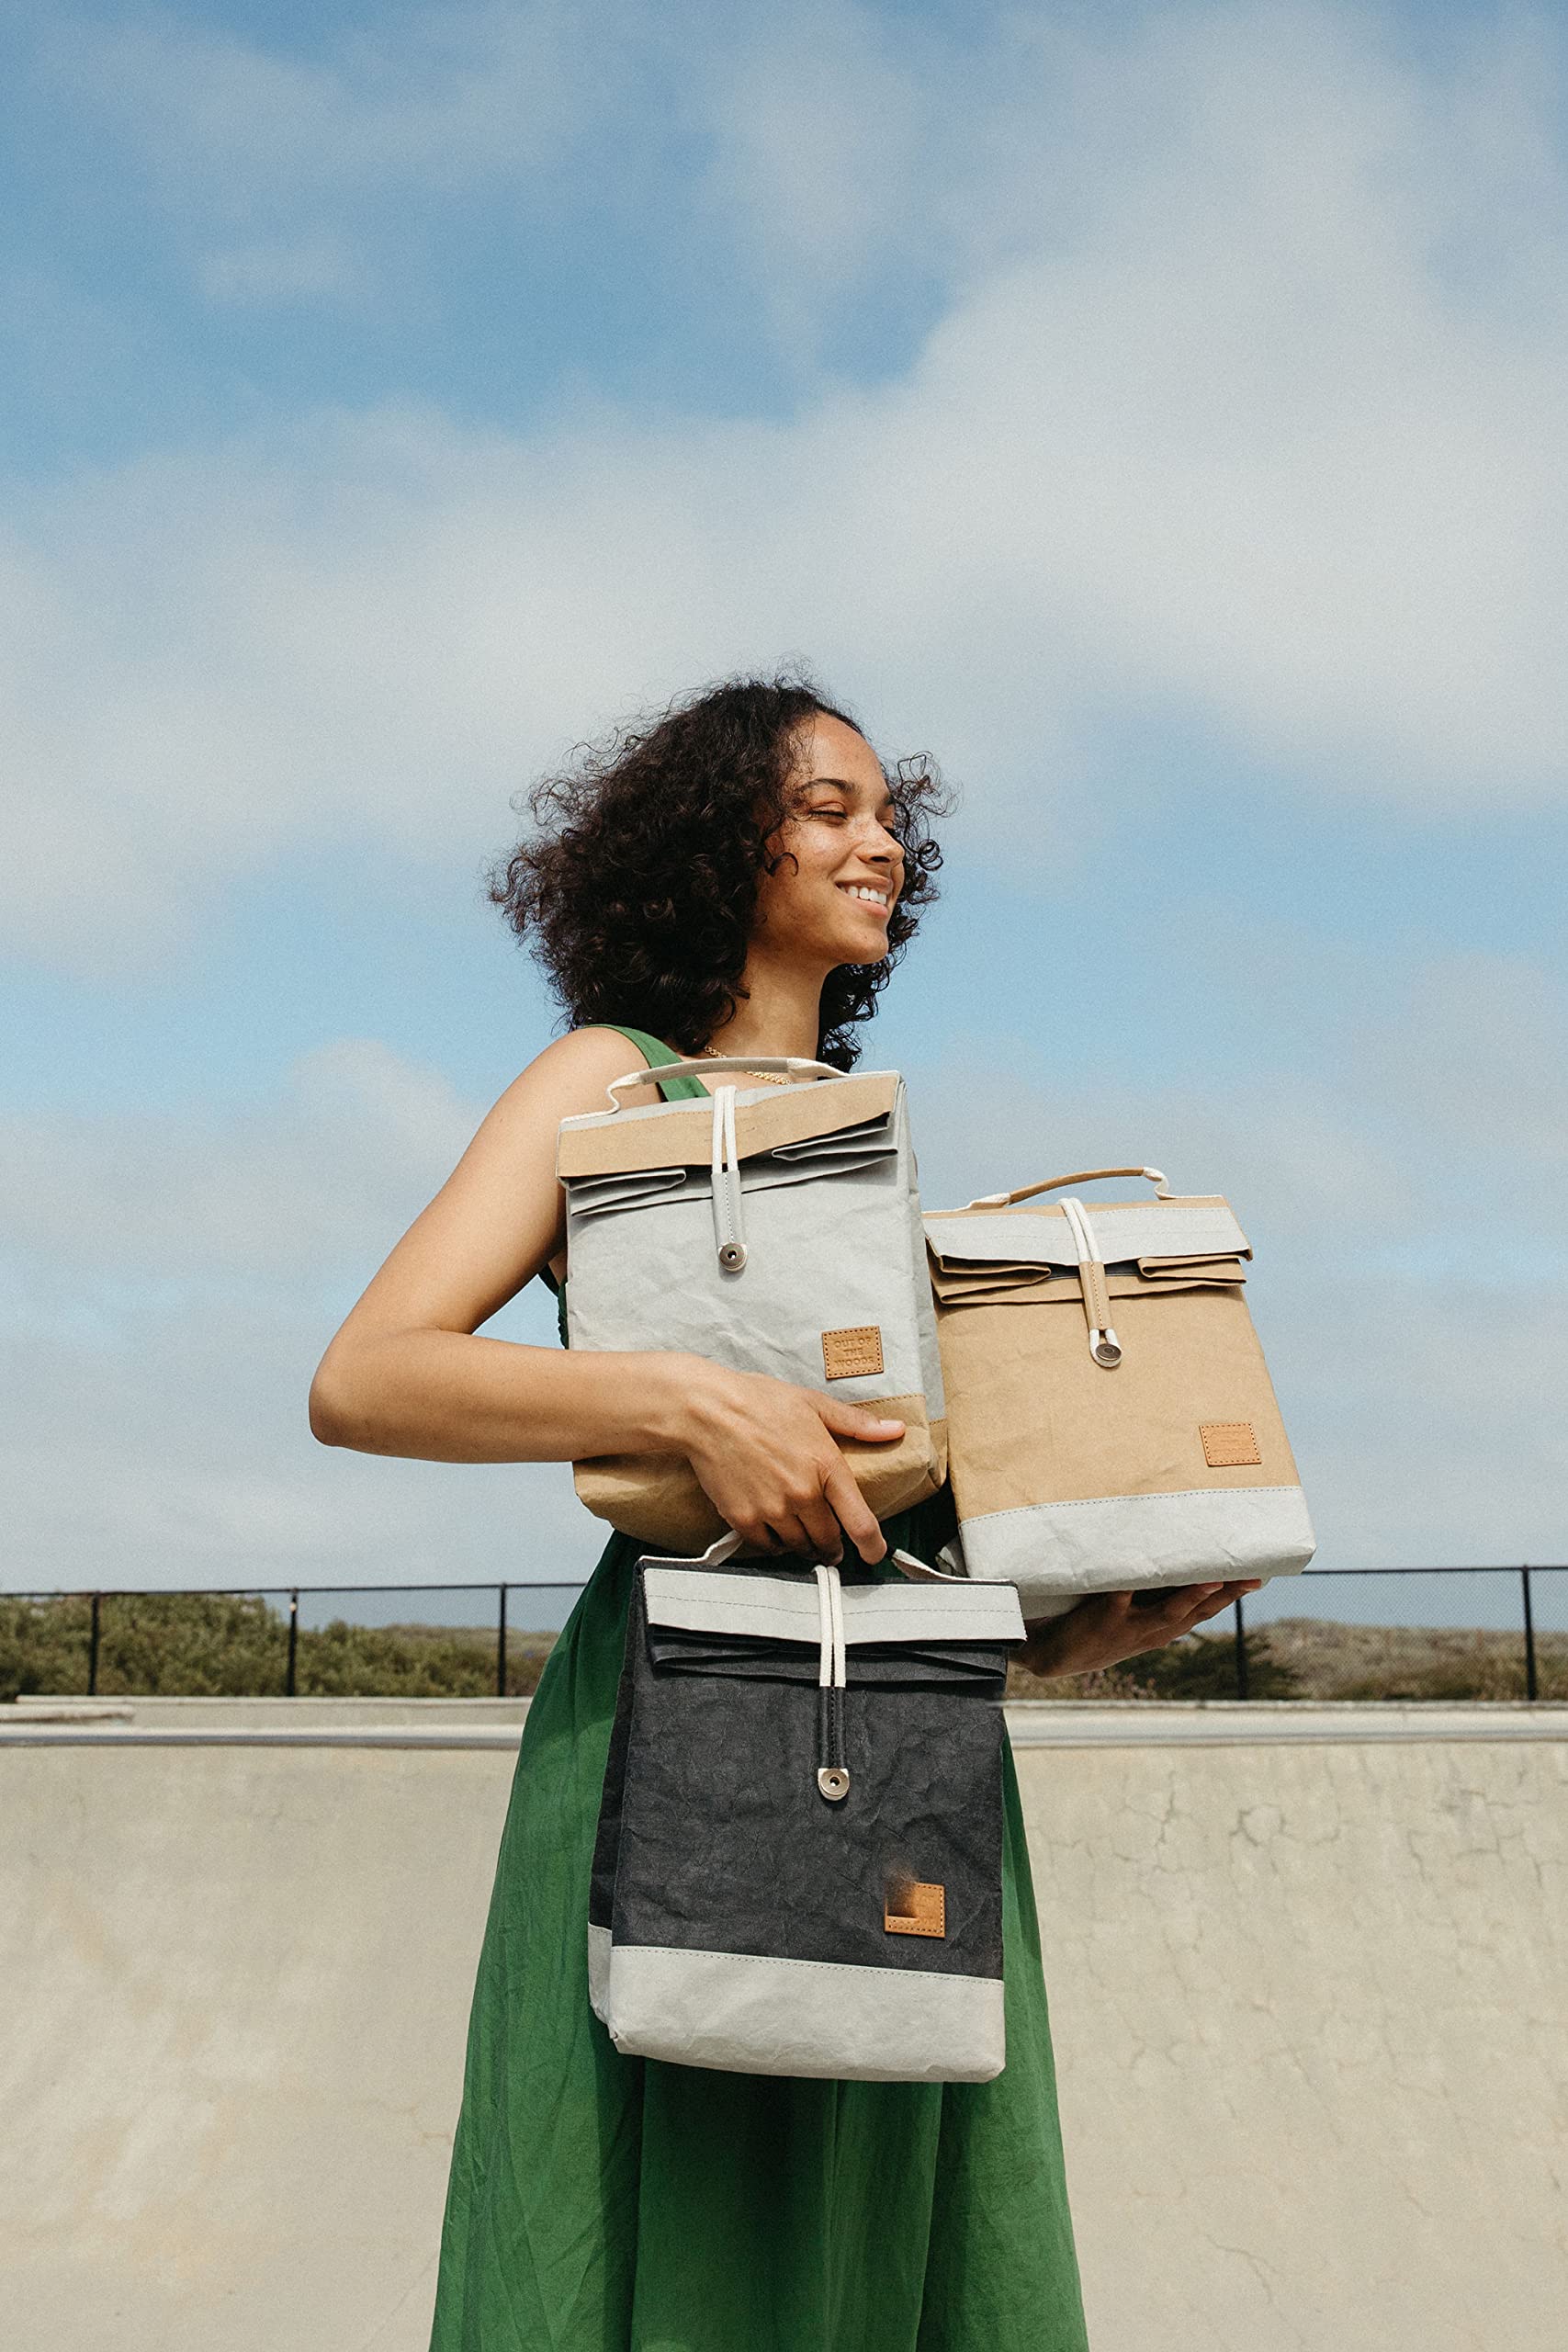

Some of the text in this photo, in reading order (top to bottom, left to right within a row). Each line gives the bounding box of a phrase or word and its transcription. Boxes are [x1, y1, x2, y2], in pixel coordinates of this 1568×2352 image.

[834, 1339, 854, 1348] OUT
[843, 1347, 863, 1356] THE
[834, 1356, 874, 1366] WOODS
